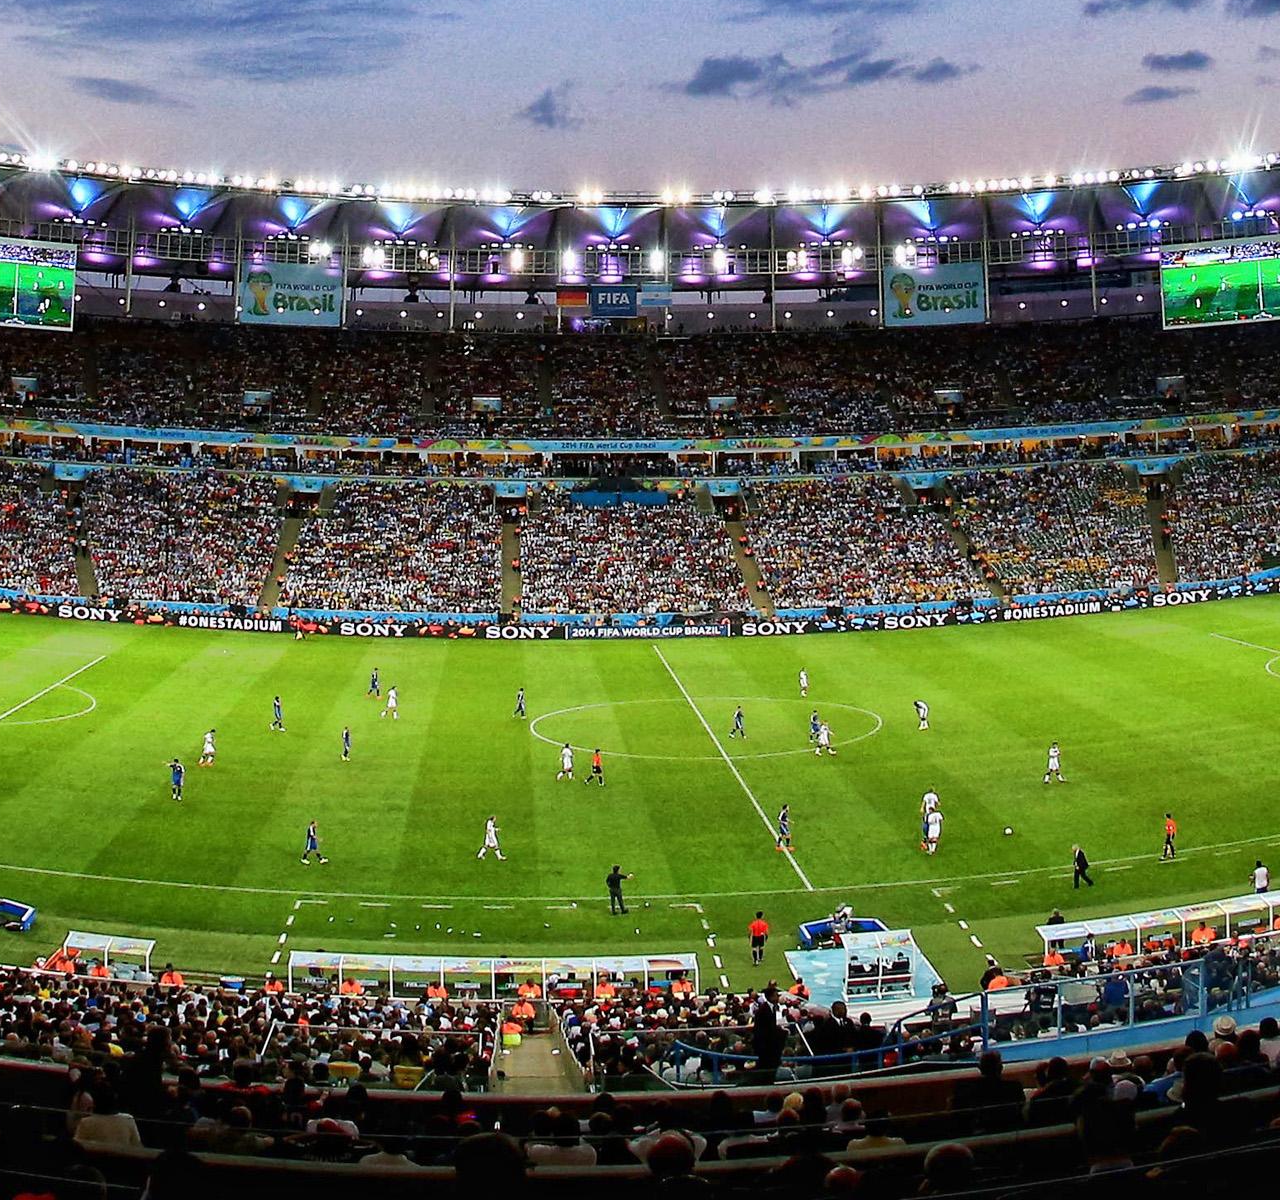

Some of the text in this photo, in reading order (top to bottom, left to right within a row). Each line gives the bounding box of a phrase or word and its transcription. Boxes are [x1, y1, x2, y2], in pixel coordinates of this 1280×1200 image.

[935, 283, 963, 291] WORLD
[964, 281, 979, 289] CUP
[273, 292, 335, 312] Brasil
[598, 293, 630, 305] FIFA
[917, 290, 978, 312] Brasil
[1152, 589, 1212, 607] SONY
[58, 605, 122, 622] SONY
[1003, 602, 1101, 620] #ONESTADIUM
[178, 615, 282, 631] #ONESTADIUM
[742, 622, 806, 636] SONY
[884, 614, 948, 629] SONY
[340, 622, 408, 637] SONY
[485, 626, 553, 639] SONY
[572, 628, 595, 637] 2014
[597, 627, 620, 637] FIFA
[622, 627, 660, 637] WORLD
[661, 626, 683, 636] CUP
